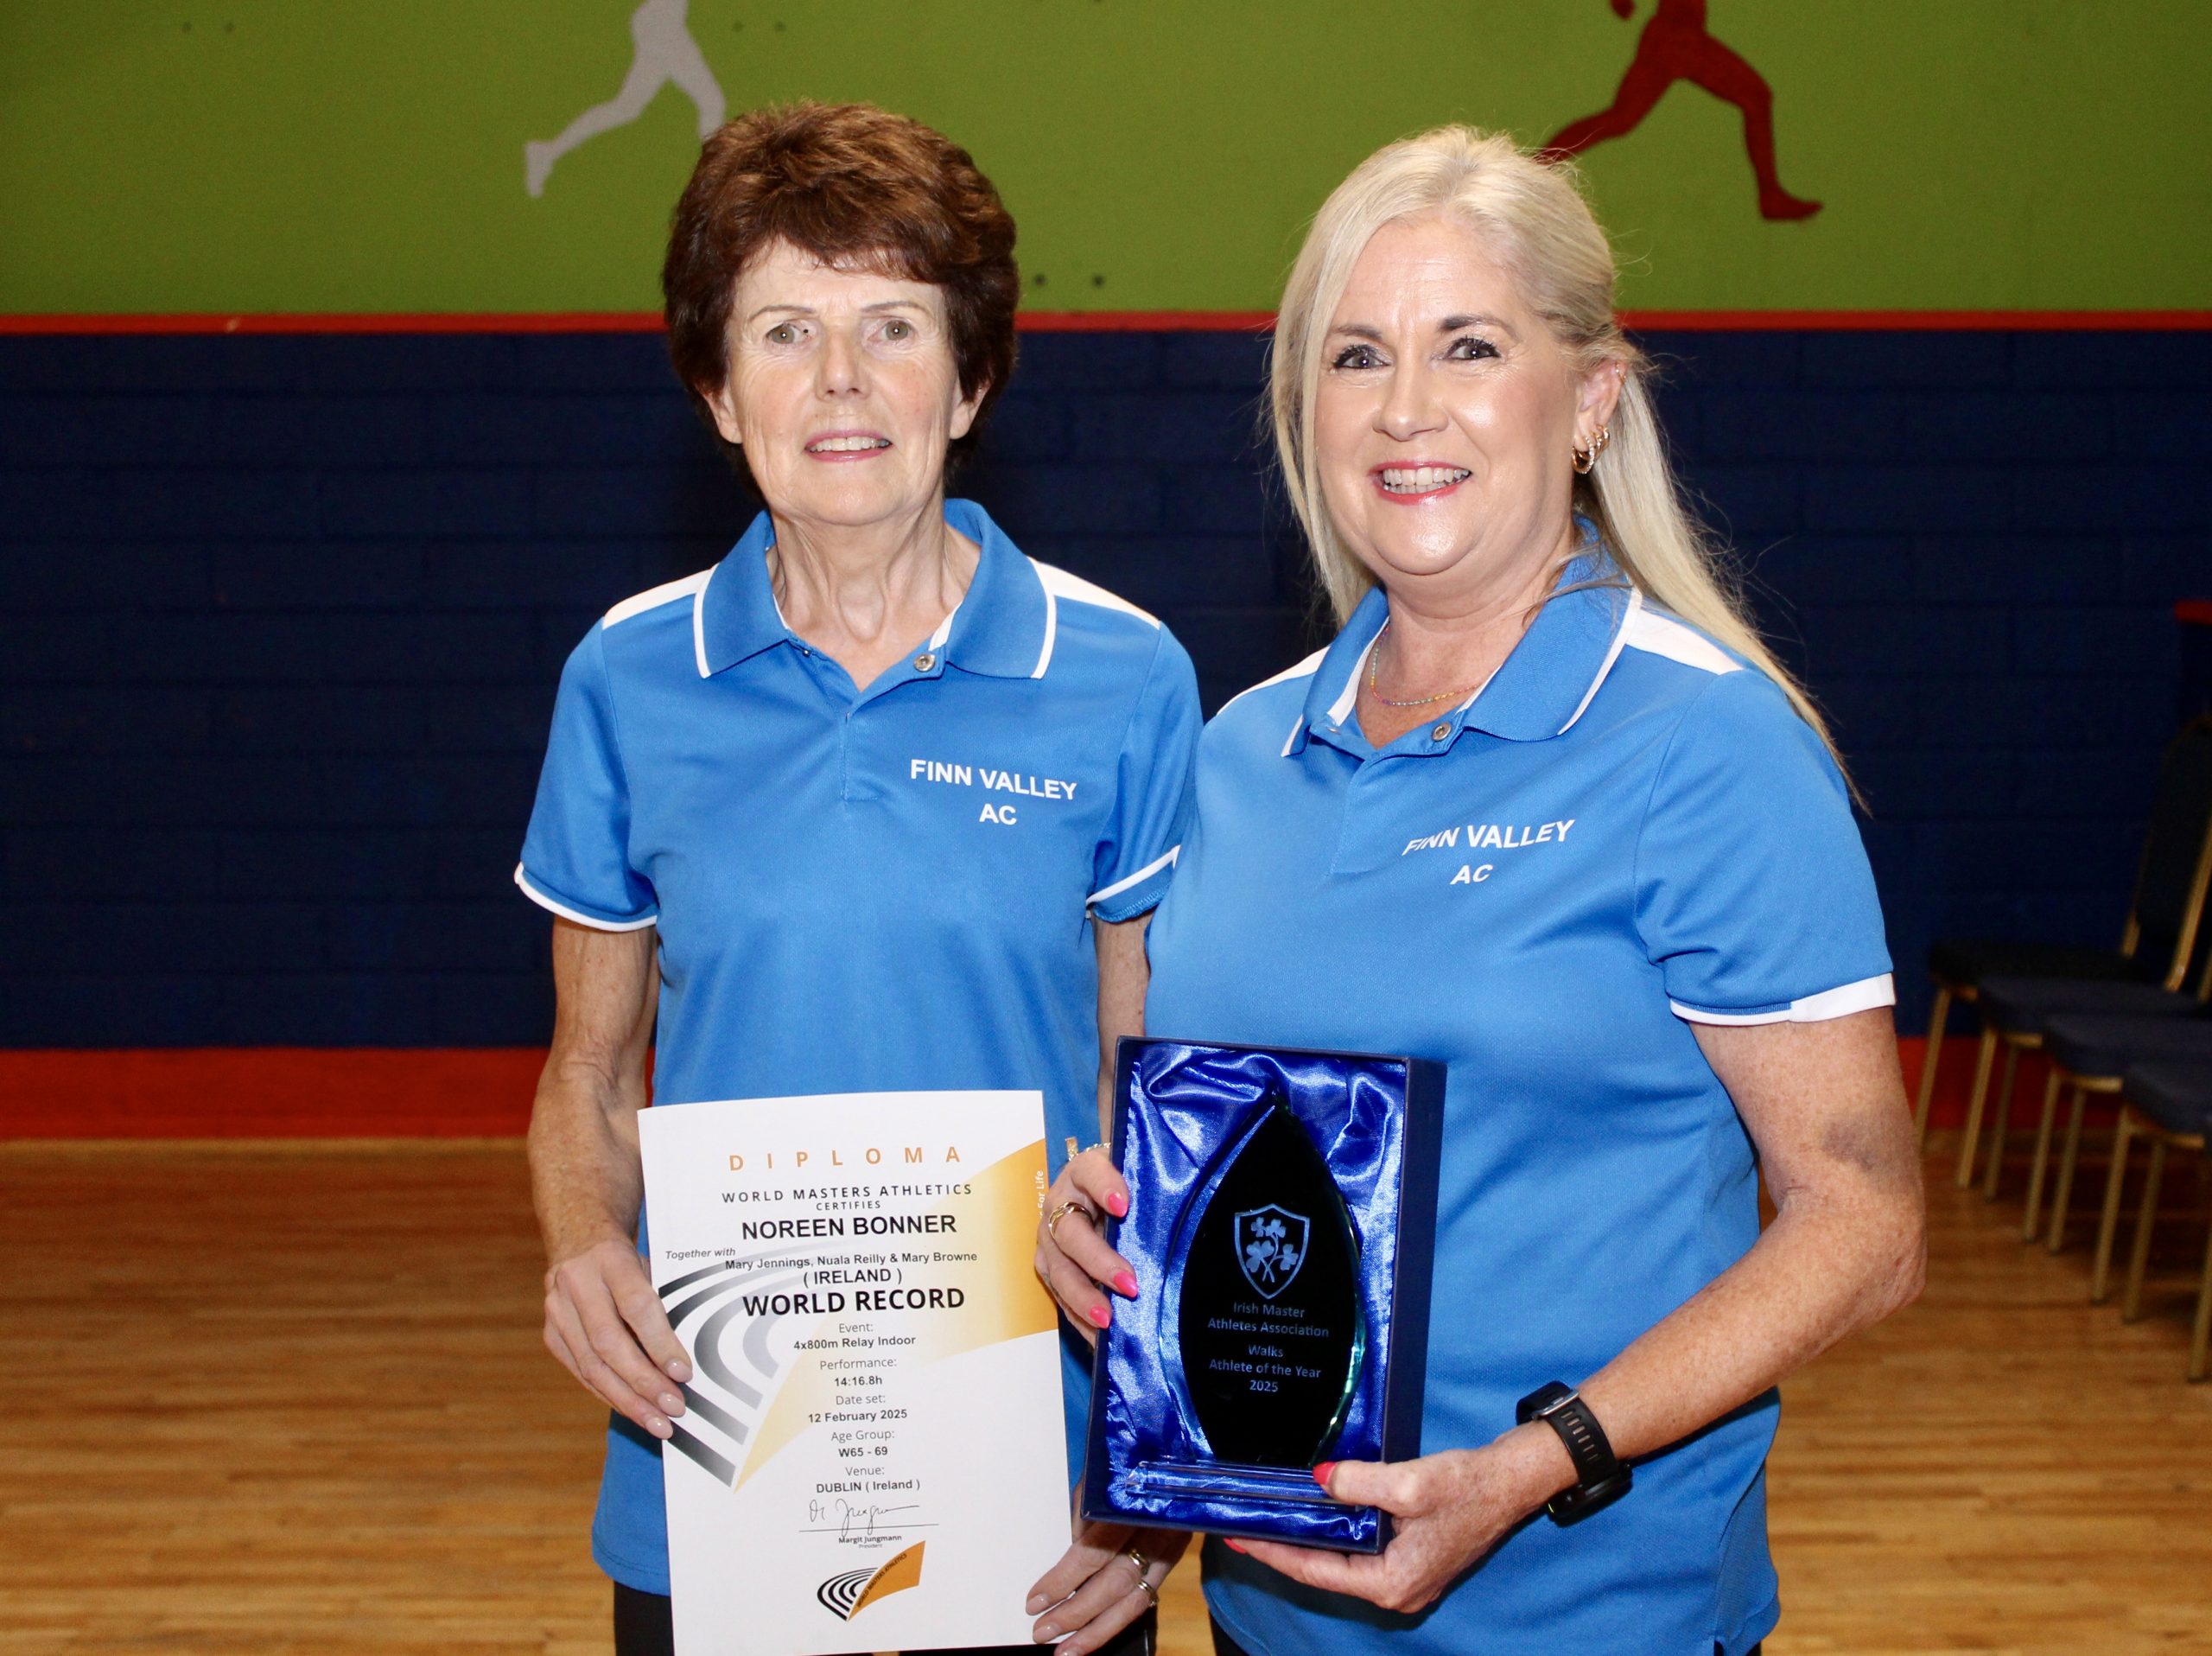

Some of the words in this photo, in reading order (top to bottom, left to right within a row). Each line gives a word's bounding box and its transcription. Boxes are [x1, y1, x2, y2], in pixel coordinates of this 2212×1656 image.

[910, 759, 973, 787] FINN
[979, 768, 1077, 800] VALLEY
[978, 803, 1018, 826] AC
[1401, 826, 1461, 856] FINN
[1467, 818, 1576, 849] VALLEY
[1450, 864, 1494, 886] AC
[729, 1146, 960, 1171] DIPLOMA
[1035, 1170, 1045, 1189] Life
[722, 1190, 784, 1203] WORLD
[793, 1186, 871, 1200] MASTERS
[880, 1184, 972, 1197] ATHLETICS
[817, 1201, 881, 1211] CERTIFIES
[742, 1218, 845, 1239] NOREEN
[854, 1214, 957, 1235] BONNER
[665, 1249, 711, 1261] Together
[714, 1248, 736, 1258] with
[726, 1259, 753, 1271] Mary
[757, 1257, 814, 1270] Jennings,
[817, 1255, 850, 1265] Nuala
[854, 1253, 887, 1266] Reilly
[890, 1253, 898, 1262] &
[901, 1252, 930, 1264] Mary
[933, 1252, 978, 1262] Browne
[814, 1269, 892, 1285] IRELAND
[743, 1292, 845, 1317] WORLD
[855, 1288, 965, 1312] RECORD
[1233, 1302, 1259, 1315] Irish
[1262, 1303, 1305, 1318] Master
[839, 1323, 874, 1334] Event:
[1208, 1317, 1256, 1332] Athletes
[1261, 1322, 1329, 1337] Association
[793, 1340, 838, 1350] 4x800m
[842, 1337, 874, 1349] Relay
[878, 1335, 917, 1346] Indoor
[1248, 1345, 1284, 1358] Walks
[820, 1358, 898, 1370] Performance:
[1209, 1359, 1253, 1373] Athlete
[1255, 1363, 1269, 1373] of
[1272, 1364, 1292, 1376] the
[1295, 1366, 1321, 1378] Year
[835, 1375, 883, 1386] 14:16.8h
[1249, 1379, 1279, 1392] 2025
[836, 1395, 862, 1405] Date
[866, 1394, 886, 1404] set:
[808, 1413, 821, 1423] 12
[824, 1411, 877, 1423] February
[880, 1409, 907, 1419] 2025
[830, 1431, 852, 1443] Age
[855, 1430, 895, 1442] Group:
[838, 1448, 864, 1458] W65
[874, 1446, 888, 1455] 69
[845, 1466, 885, 1476] Venue:
[816, 1481, 861, 1493] DUBLIN
[873, 1479, 912, 1491] Ireland
[839, 1536, 862, 1545] Margit
[864, 1535, 902, 1545] Jungmann
